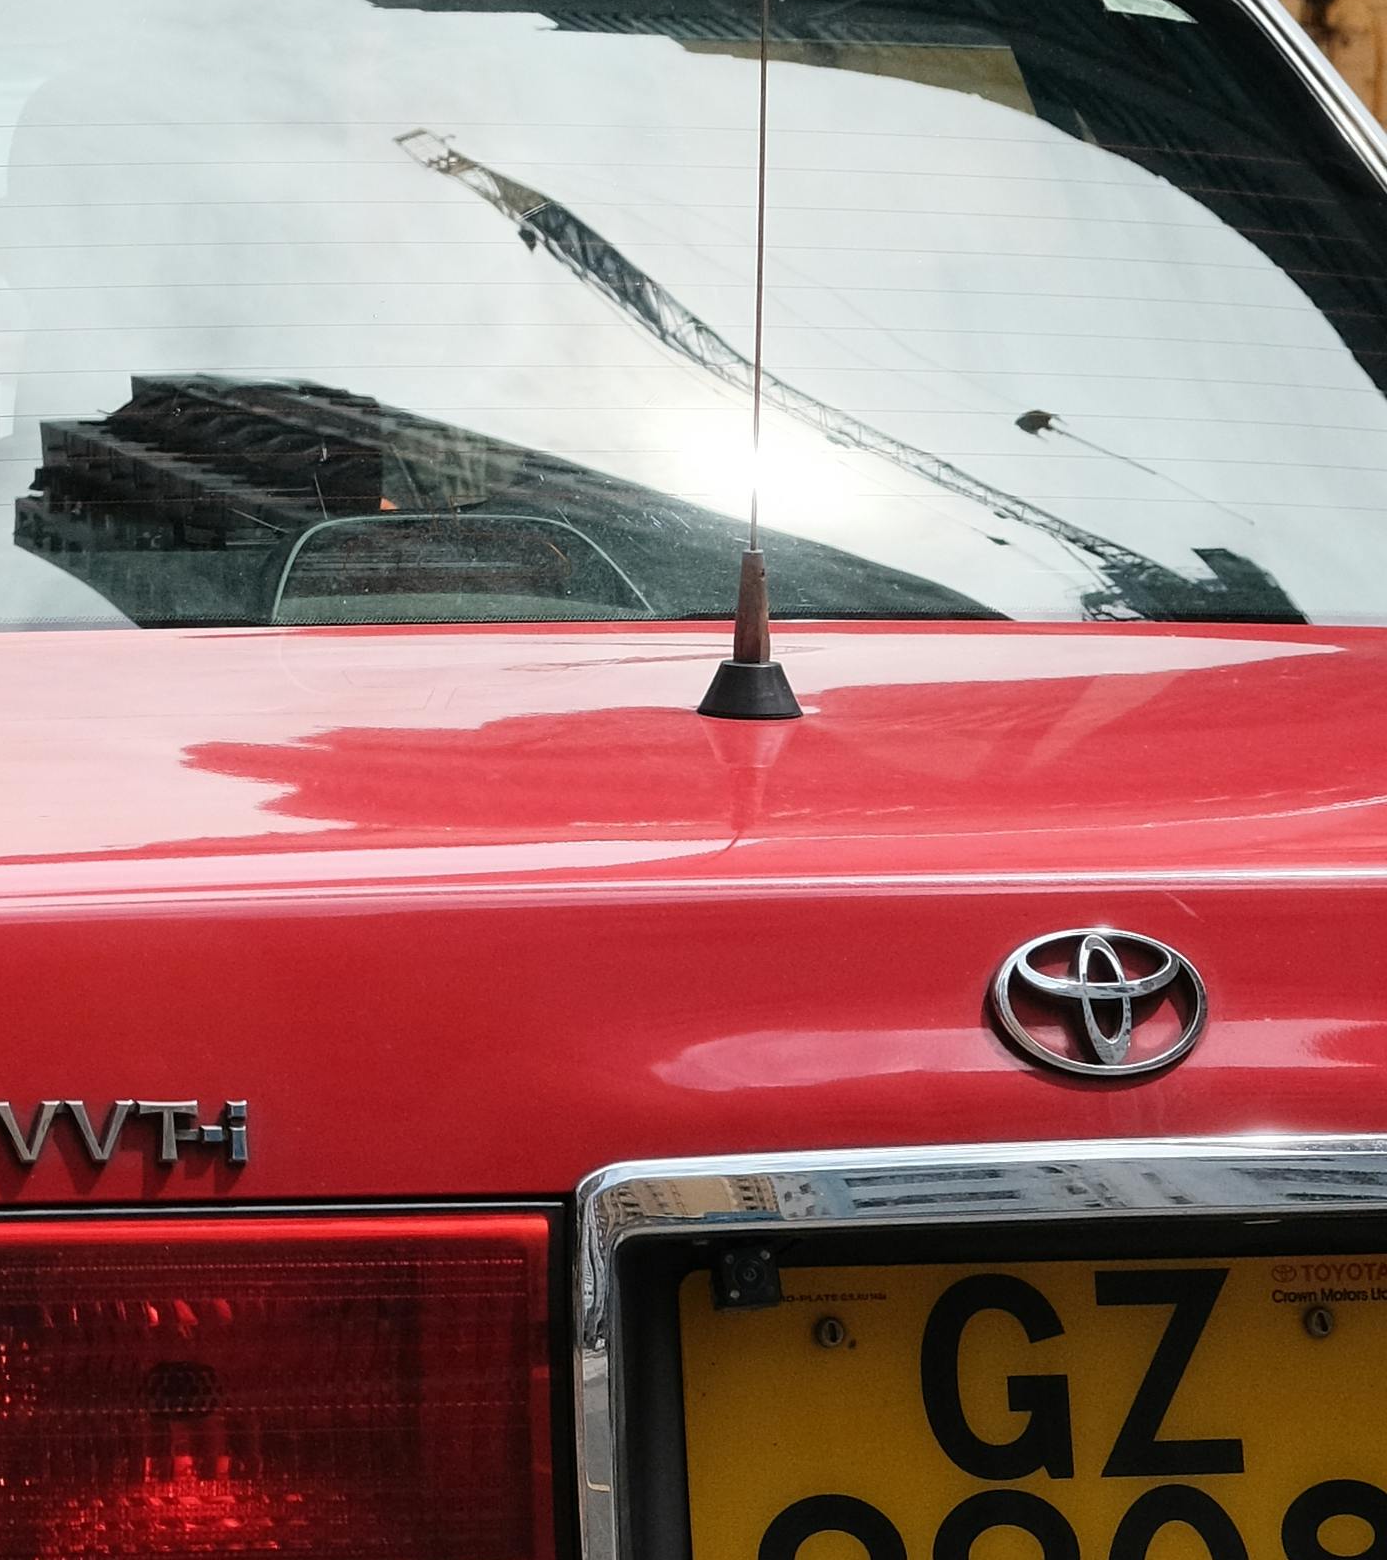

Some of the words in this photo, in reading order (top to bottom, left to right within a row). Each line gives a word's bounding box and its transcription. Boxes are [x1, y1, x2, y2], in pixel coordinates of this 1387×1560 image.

[1272, 1289, 1317, 1303] Crown
[1320, 1287, 1369, 1302] Motors
[920, 1267, 1245, 1481] GZ
